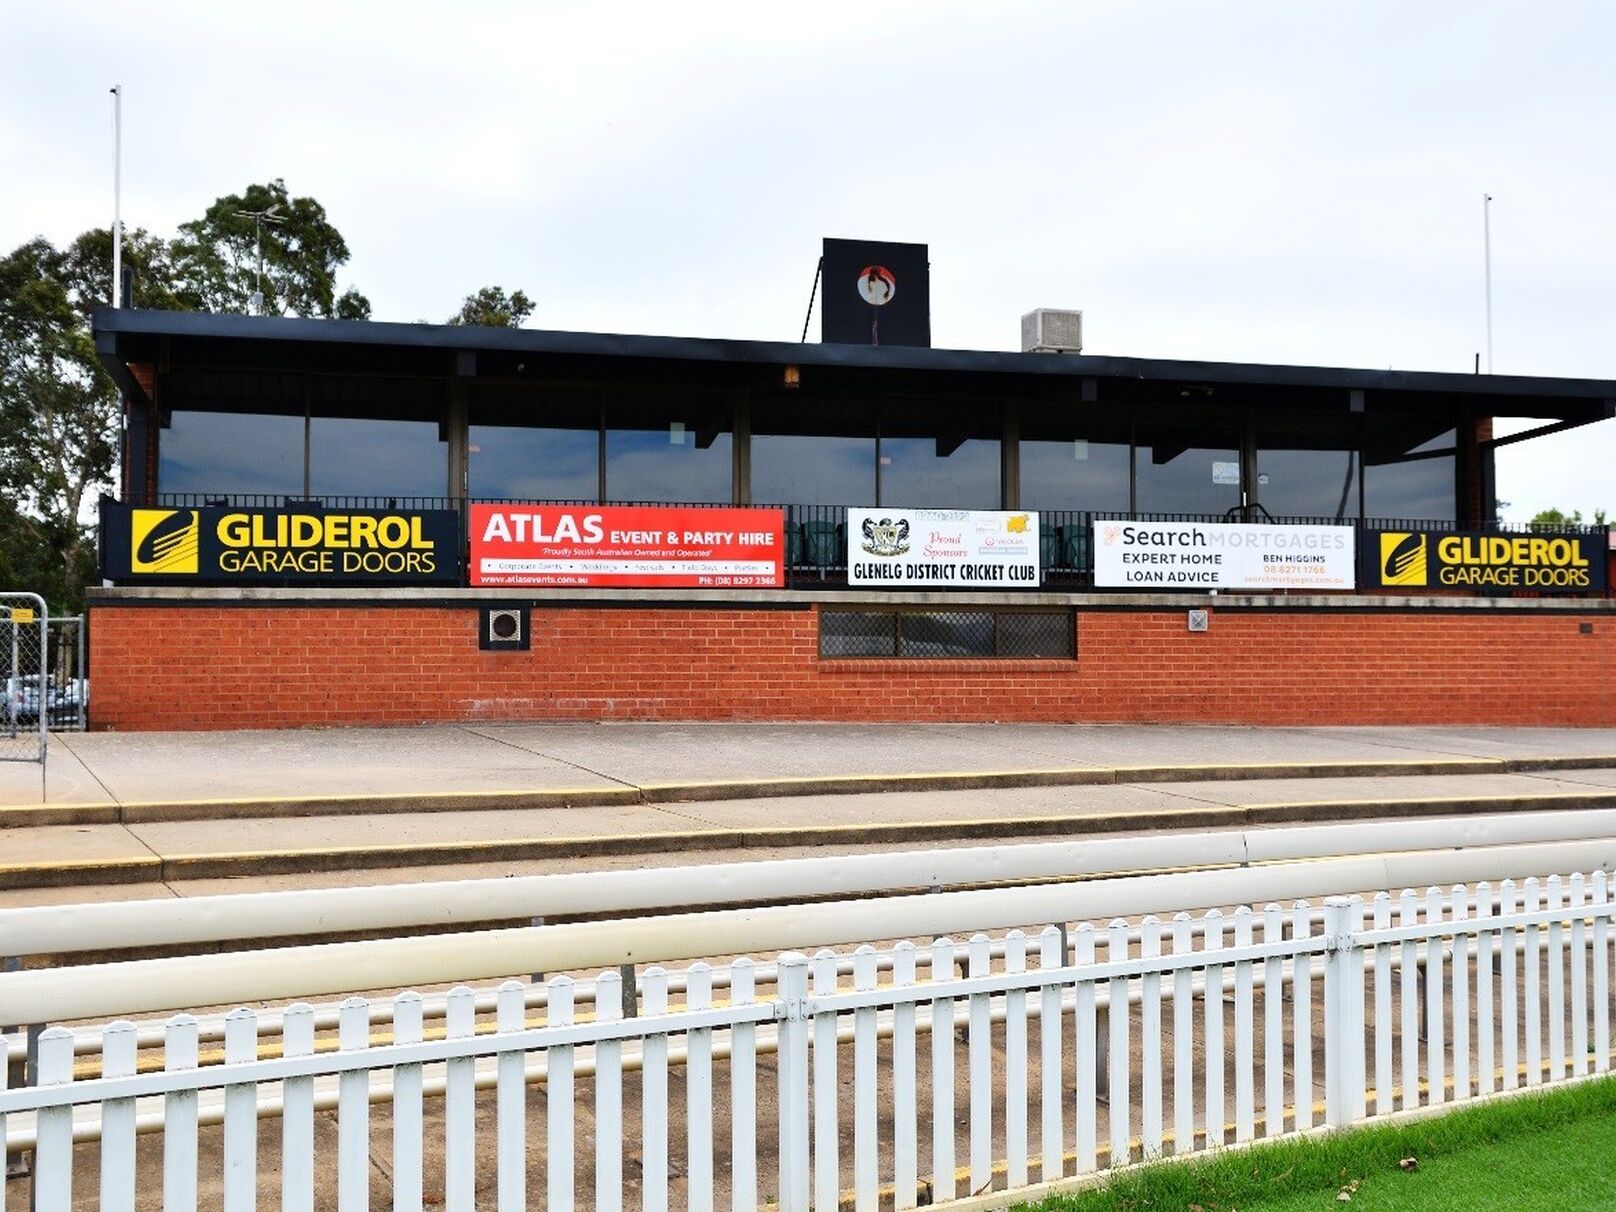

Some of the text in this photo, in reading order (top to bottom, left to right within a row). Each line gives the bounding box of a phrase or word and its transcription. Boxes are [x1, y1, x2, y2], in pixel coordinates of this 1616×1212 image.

[216, 513, 434, 549] GLIDEROL
[482, 513, 774, 546] ATLAS EVENT & PARTY HIRE
[929, 531, 961, 544] Proud
[573, 548, 594, 556] South
[596, 548, 632, 556] Australian
[634, 549, 660, 557] Owned
[661, 549, 675, 557] and
[922, 545, 968, 559] Sponsors
[1438, 536, 1588, 567] GLIDEROL
[219, 550, 435, 574] GARAGE DOORS
[1122, 553, 1222, 565] EXPERT HOME
[1263, 554, 1326, 563] BEN HIGGINS
[854, 563, 1035, 581] GLENELG DISTRICT CRICKET CLUB
[1263, 565, 1276, 574] 08
[1279, 566, 1301, 574] 8271
[698, 576, 713, 585] PH:
[1126, 571, 1219, 582] LOAN ADVICE
[1244, 576, 1344, 585] searchmortgages.com.au
[1439, 567, 1590, 587] GARAGE DOORS
